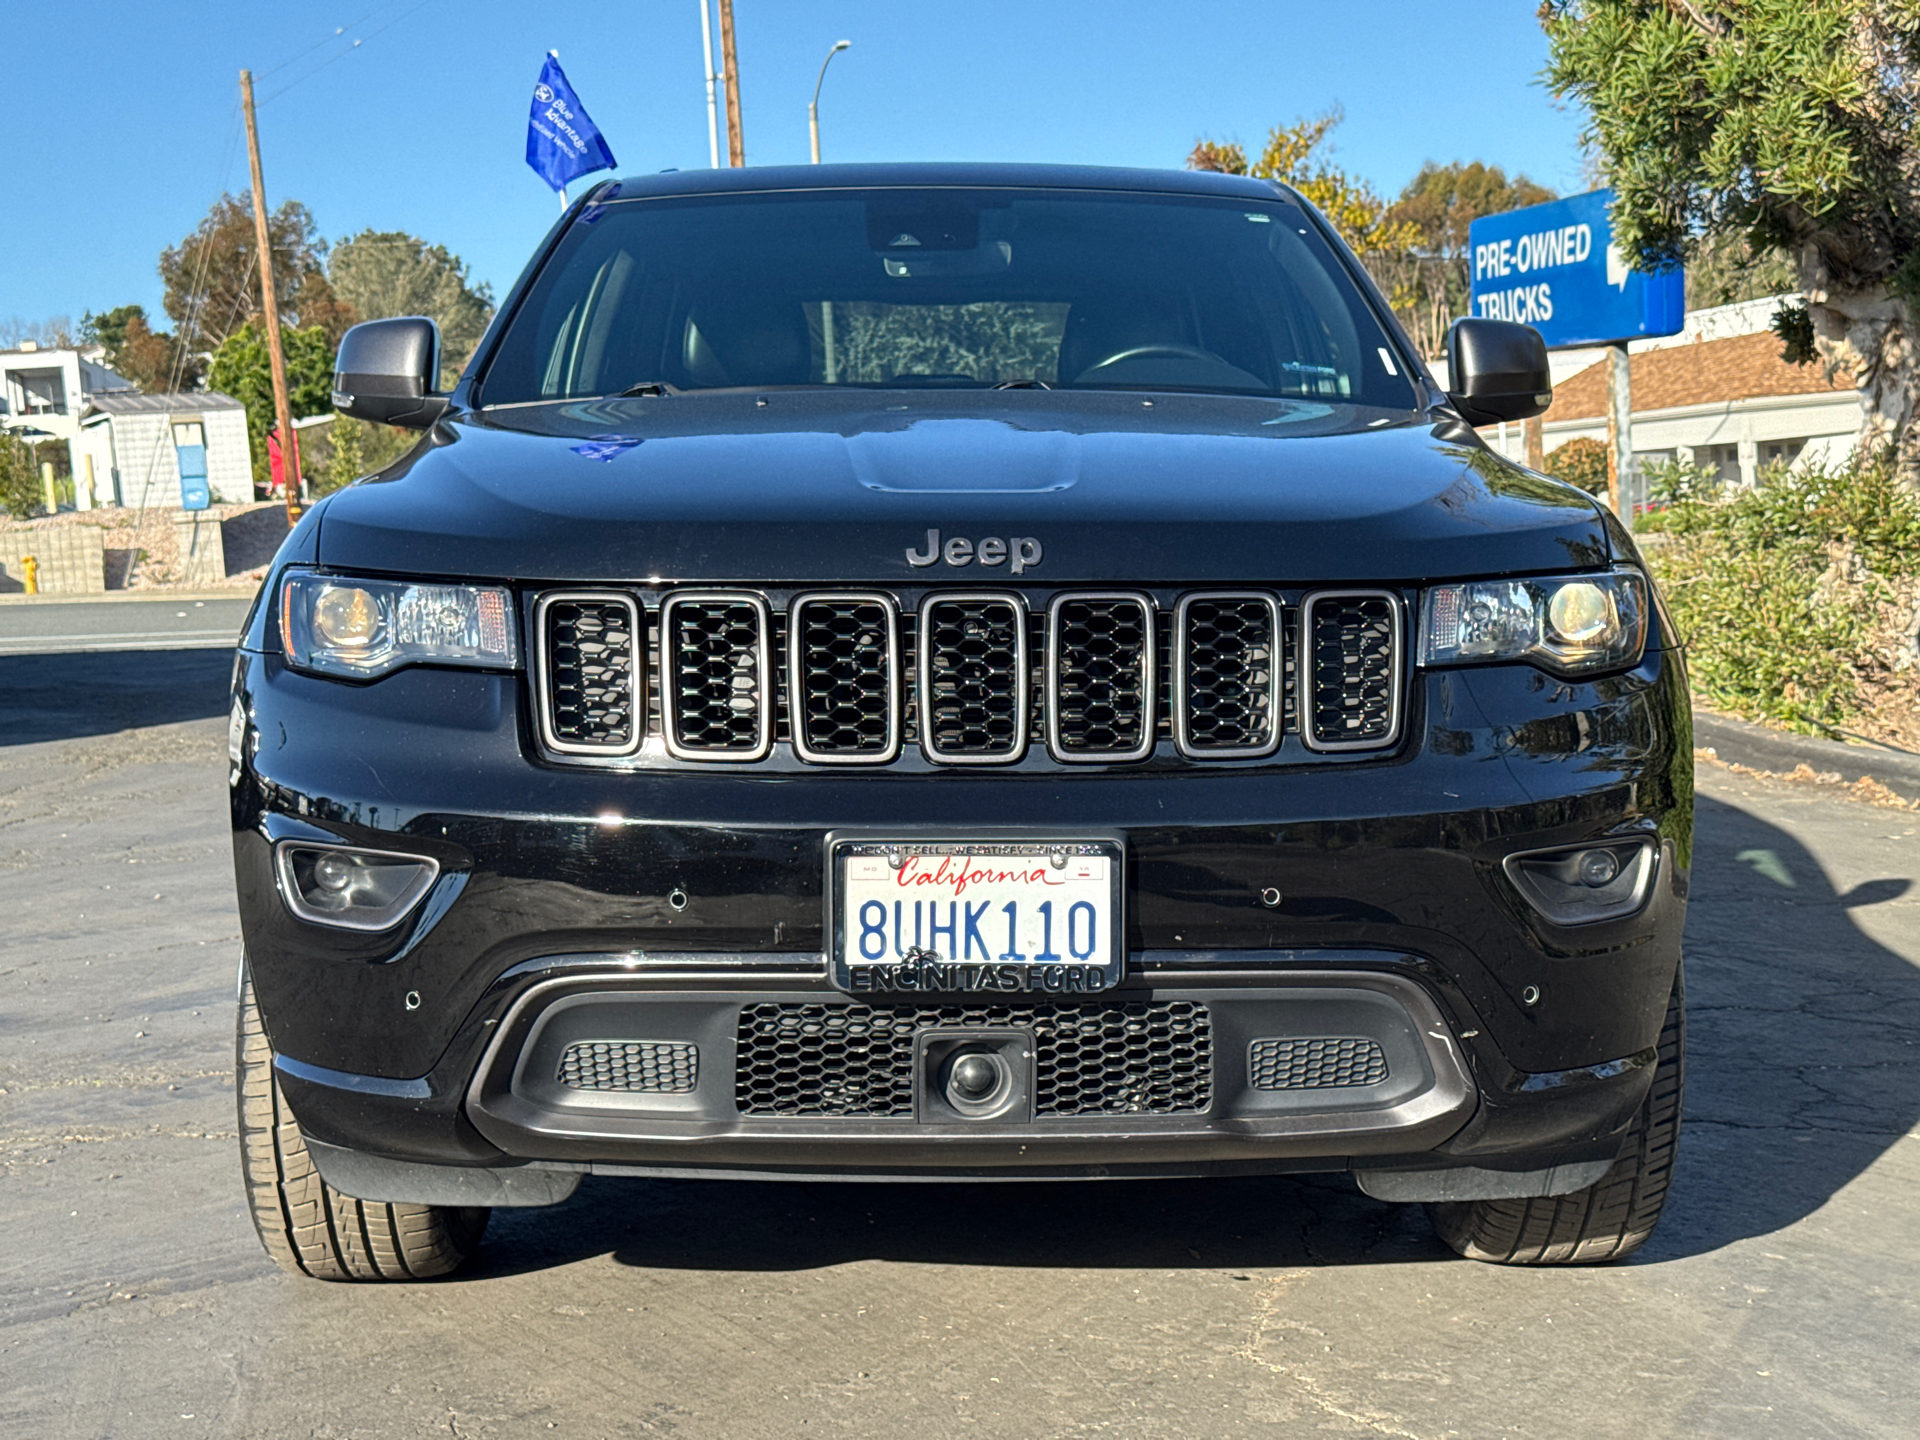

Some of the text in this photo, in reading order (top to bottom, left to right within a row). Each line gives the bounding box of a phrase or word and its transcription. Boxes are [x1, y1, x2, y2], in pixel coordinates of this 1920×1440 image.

[545, 108, 588, 154] Advantage
[552, 99, 574, 120] Blue
[1475, 223, 1592, 281] PRE-OWNED
[1477, 283, 1553, 324] TRUCKS
[905, 528, 1043, 574] Jeep
[897, 856, 1066, 896] California
[858, 899, 1097, 961] 8UHK110
[850, 965, 1106, 993] ENCINITAS FORD
